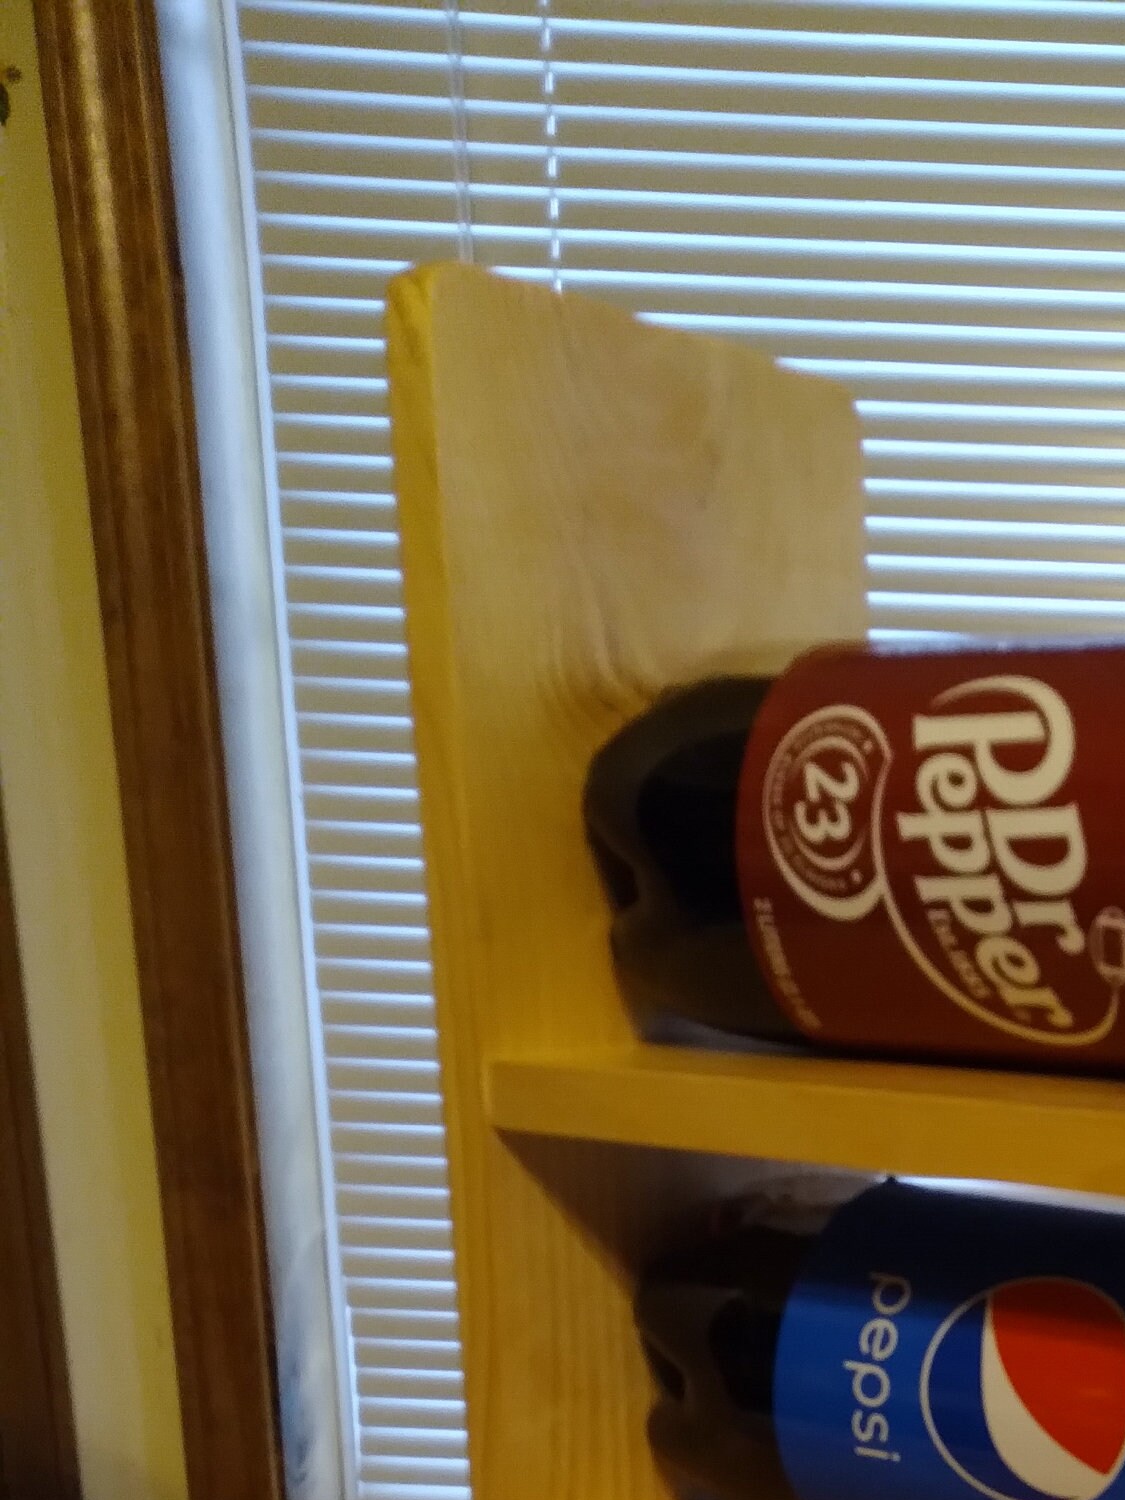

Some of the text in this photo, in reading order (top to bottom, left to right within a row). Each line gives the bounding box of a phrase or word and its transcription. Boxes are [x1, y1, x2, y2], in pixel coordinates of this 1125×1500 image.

[794, 761, 860, 845] 23
[896, 675, 1076, 1028] Pepper
[984, 802, 1087, 955] Dr
[842, 1272, 912, 1463] pepsi
